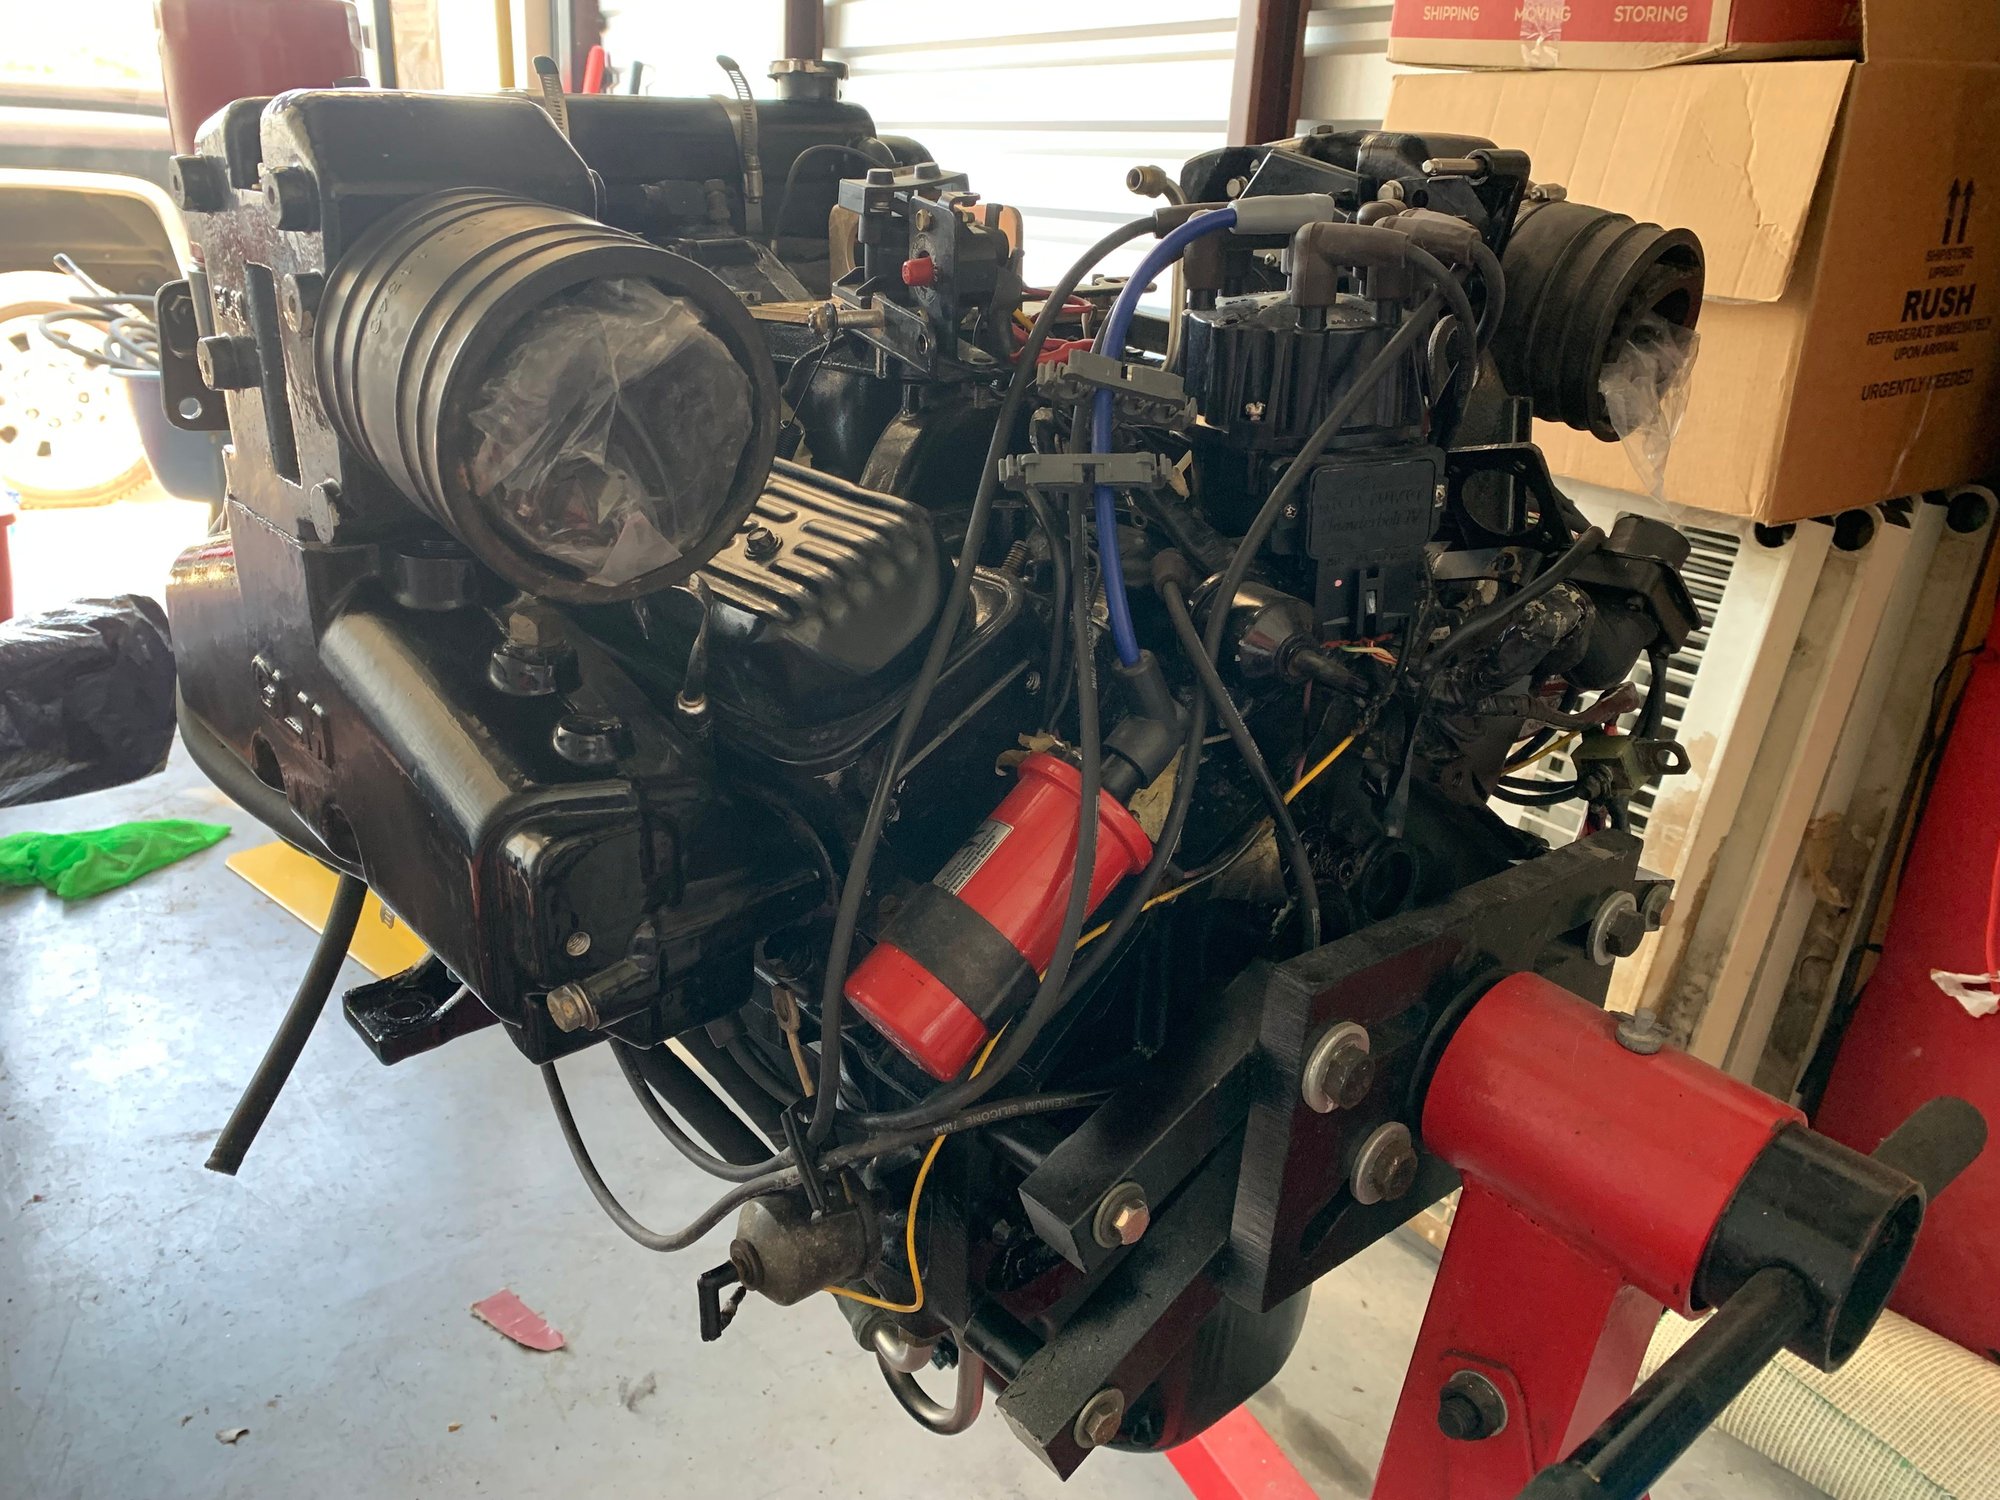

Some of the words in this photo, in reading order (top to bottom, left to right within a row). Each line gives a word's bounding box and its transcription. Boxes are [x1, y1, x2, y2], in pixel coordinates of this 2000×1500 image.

[1423, 5, 1480, 22] SHIPPING
[1514, 5, 1572, 22] MOVING
[1613, 4, 1689, 23] STORING
[1929, 265, 1965, 279] UPRIGHT
[1901, 283, 1977, 322] RUSH
[1867, 326, 1935, 346] REFRIGERATE
[1935, 317, 1992, 336] IMMEDIATELY
[1893, 345, 1921, 361] UPON
[1921, 341, 1960, 356] ARRIVAL
[1861, 376, 1926, 401] URGENTLY
[1926, 369, 1974, 390] NEEDED
[964, 1104, 1020, 1126] SILICONE
[932, 1121, 959, 1136] 7MM
